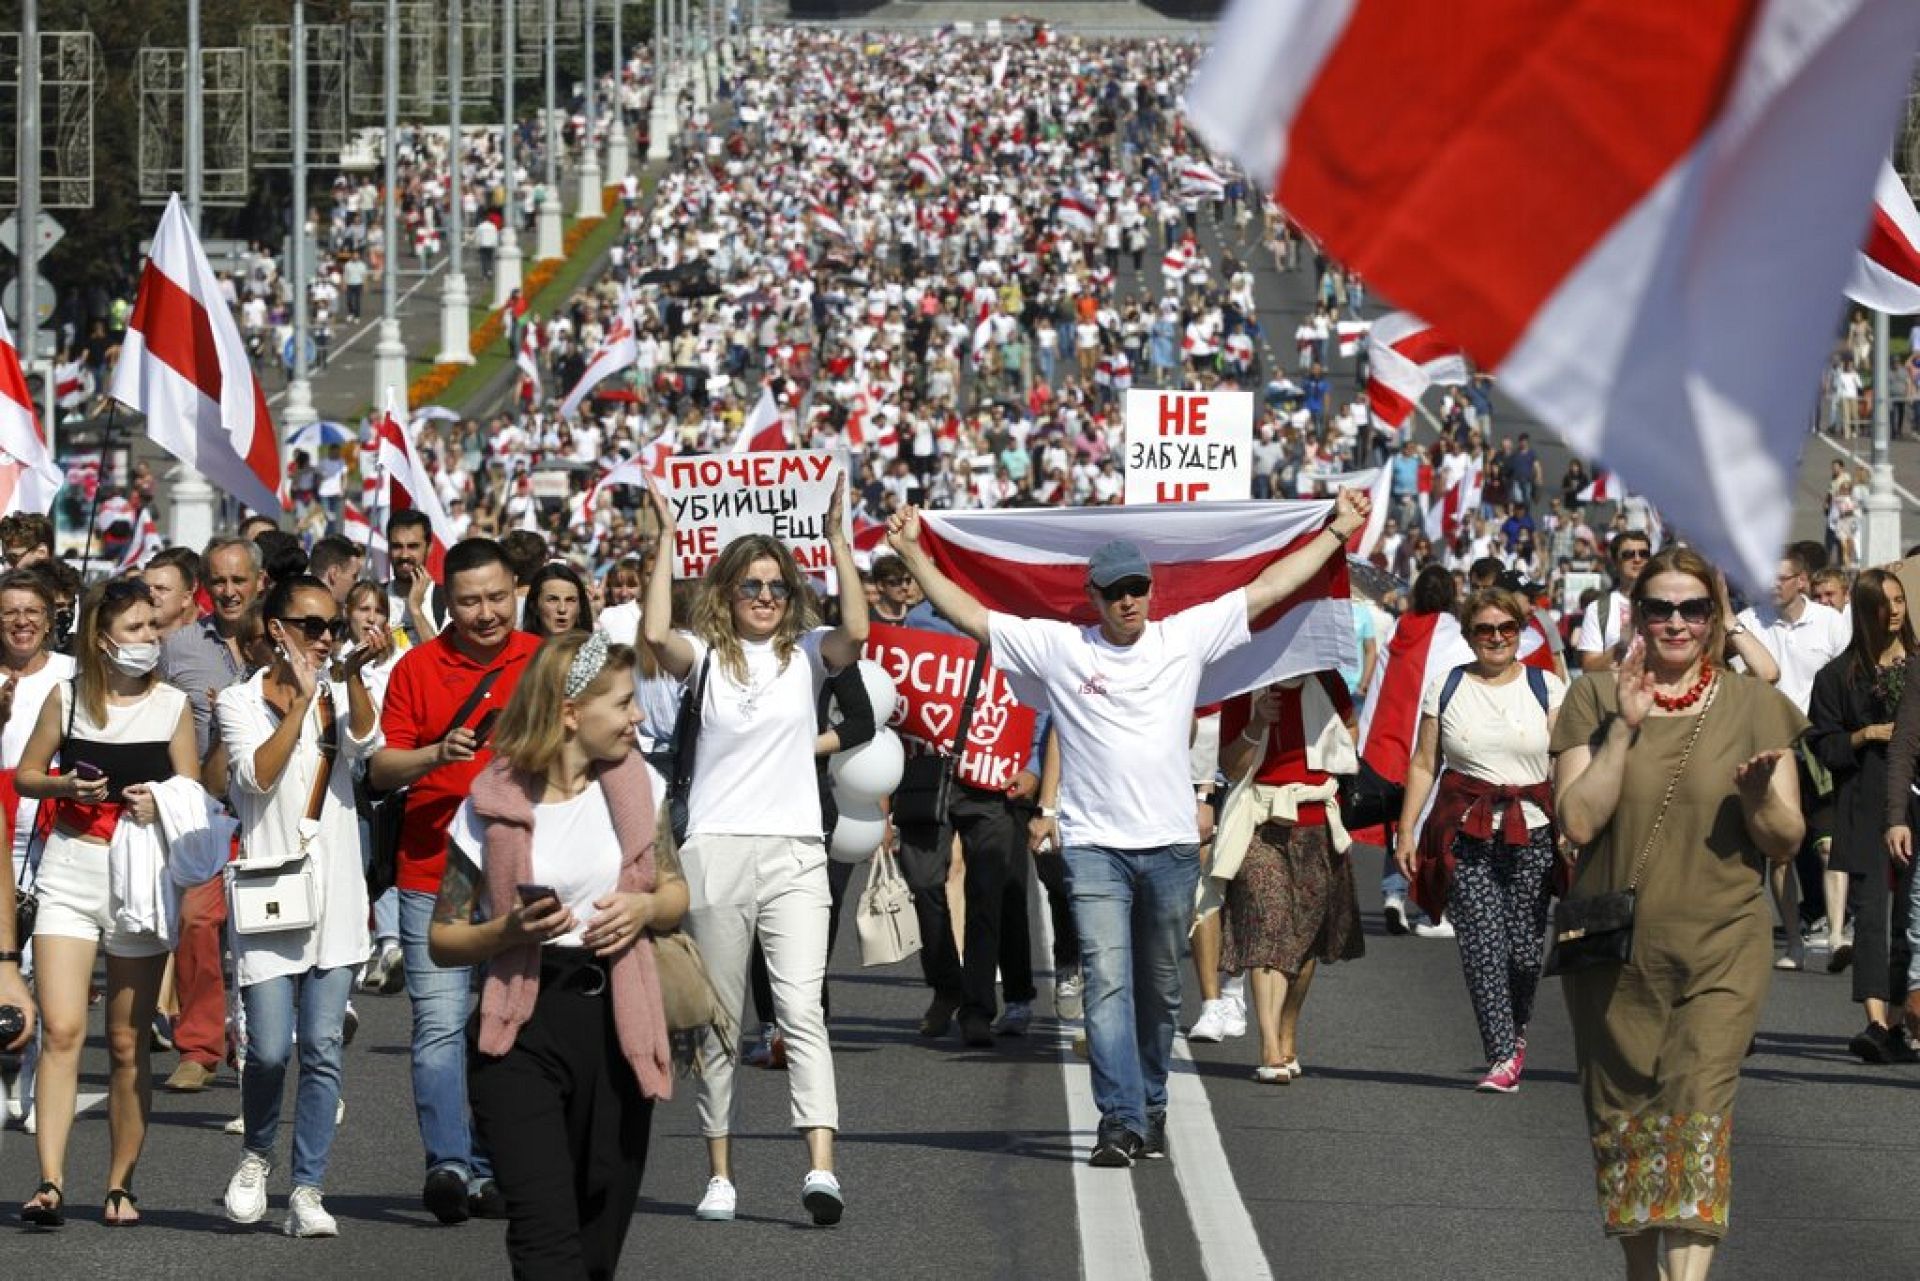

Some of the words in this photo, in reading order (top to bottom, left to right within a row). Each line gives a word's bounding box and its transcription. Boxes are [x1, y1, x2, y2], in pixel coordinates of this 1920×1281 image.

[1158, 395, 1209, 436] НЕ
[671, 455, 832, 489] ПОЧЕМУ
[1130, 442, 1237, 470] ЗАБУДЕМ
[671, 488, 798, 522] УБИЙЦЫ
[675, 526, 718, 556] НЕ
